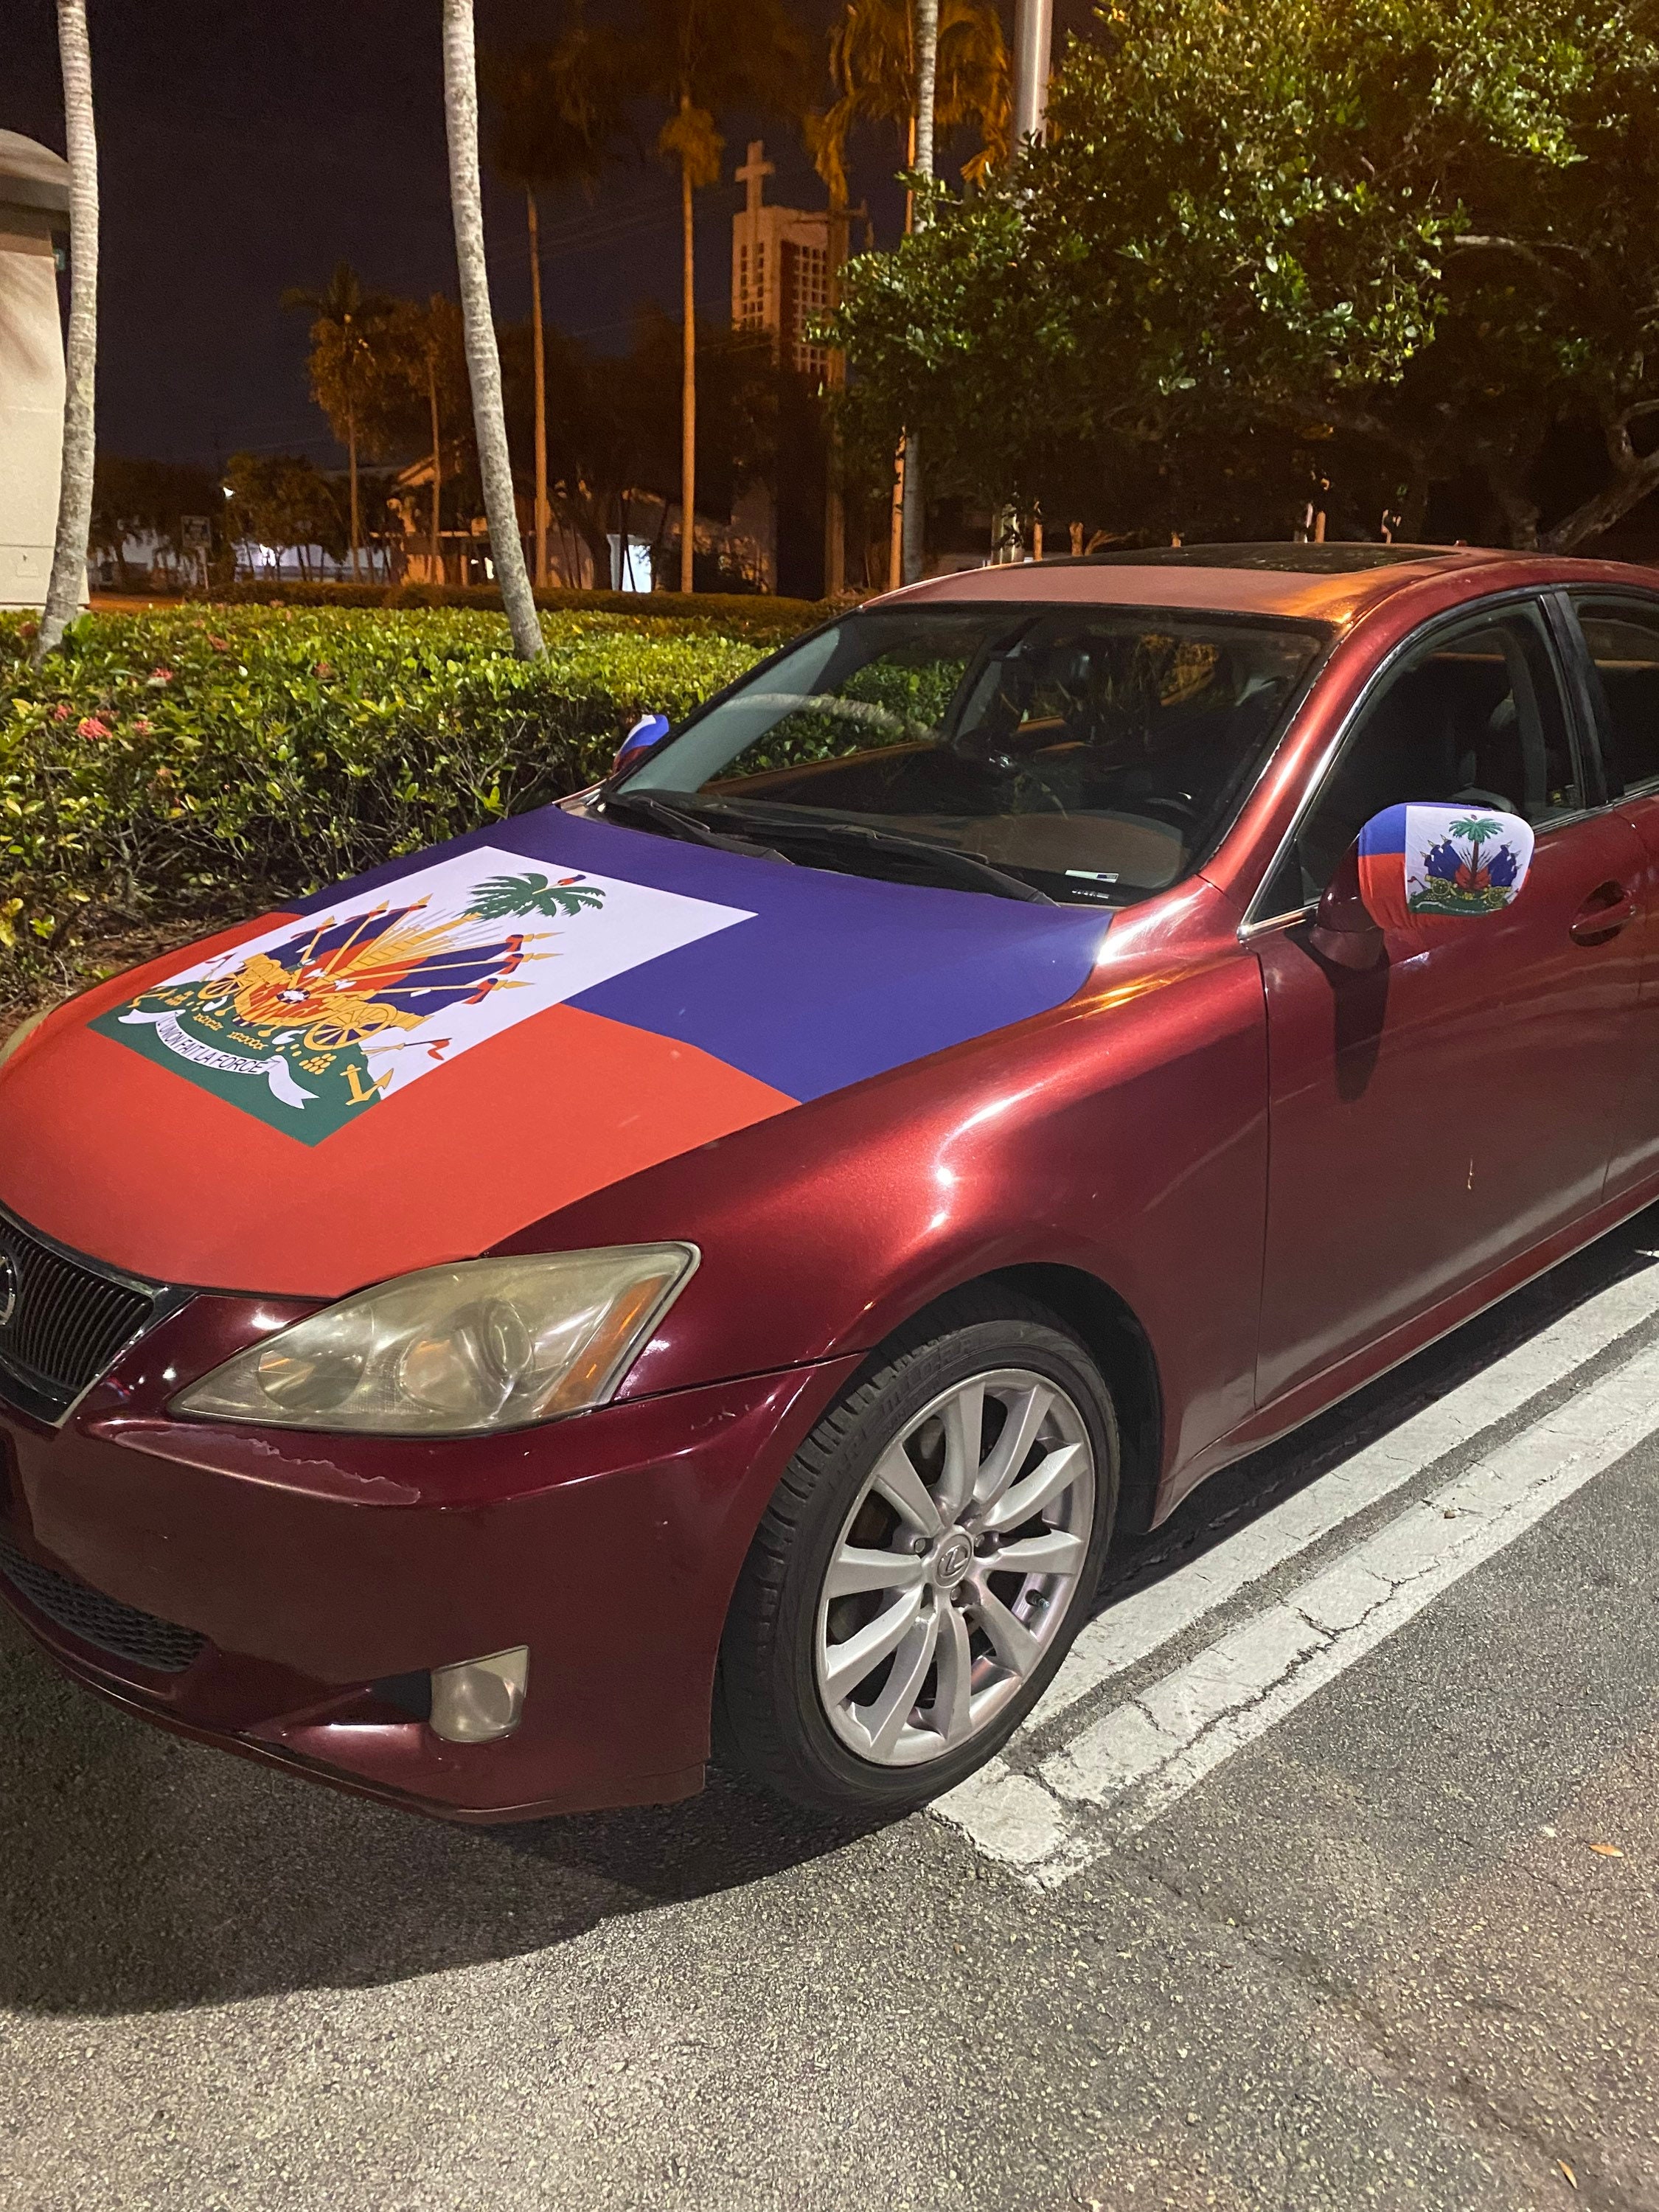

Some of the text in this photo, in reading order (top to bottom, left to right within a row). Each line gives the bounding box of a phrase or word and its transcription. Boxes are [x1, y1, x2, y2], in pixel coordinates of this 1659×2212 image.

[173, 1039, 205, 1057] FAIT
[193, 1049, 217, 1063] LA
[209, 1054, 268, 1073] FORCE
